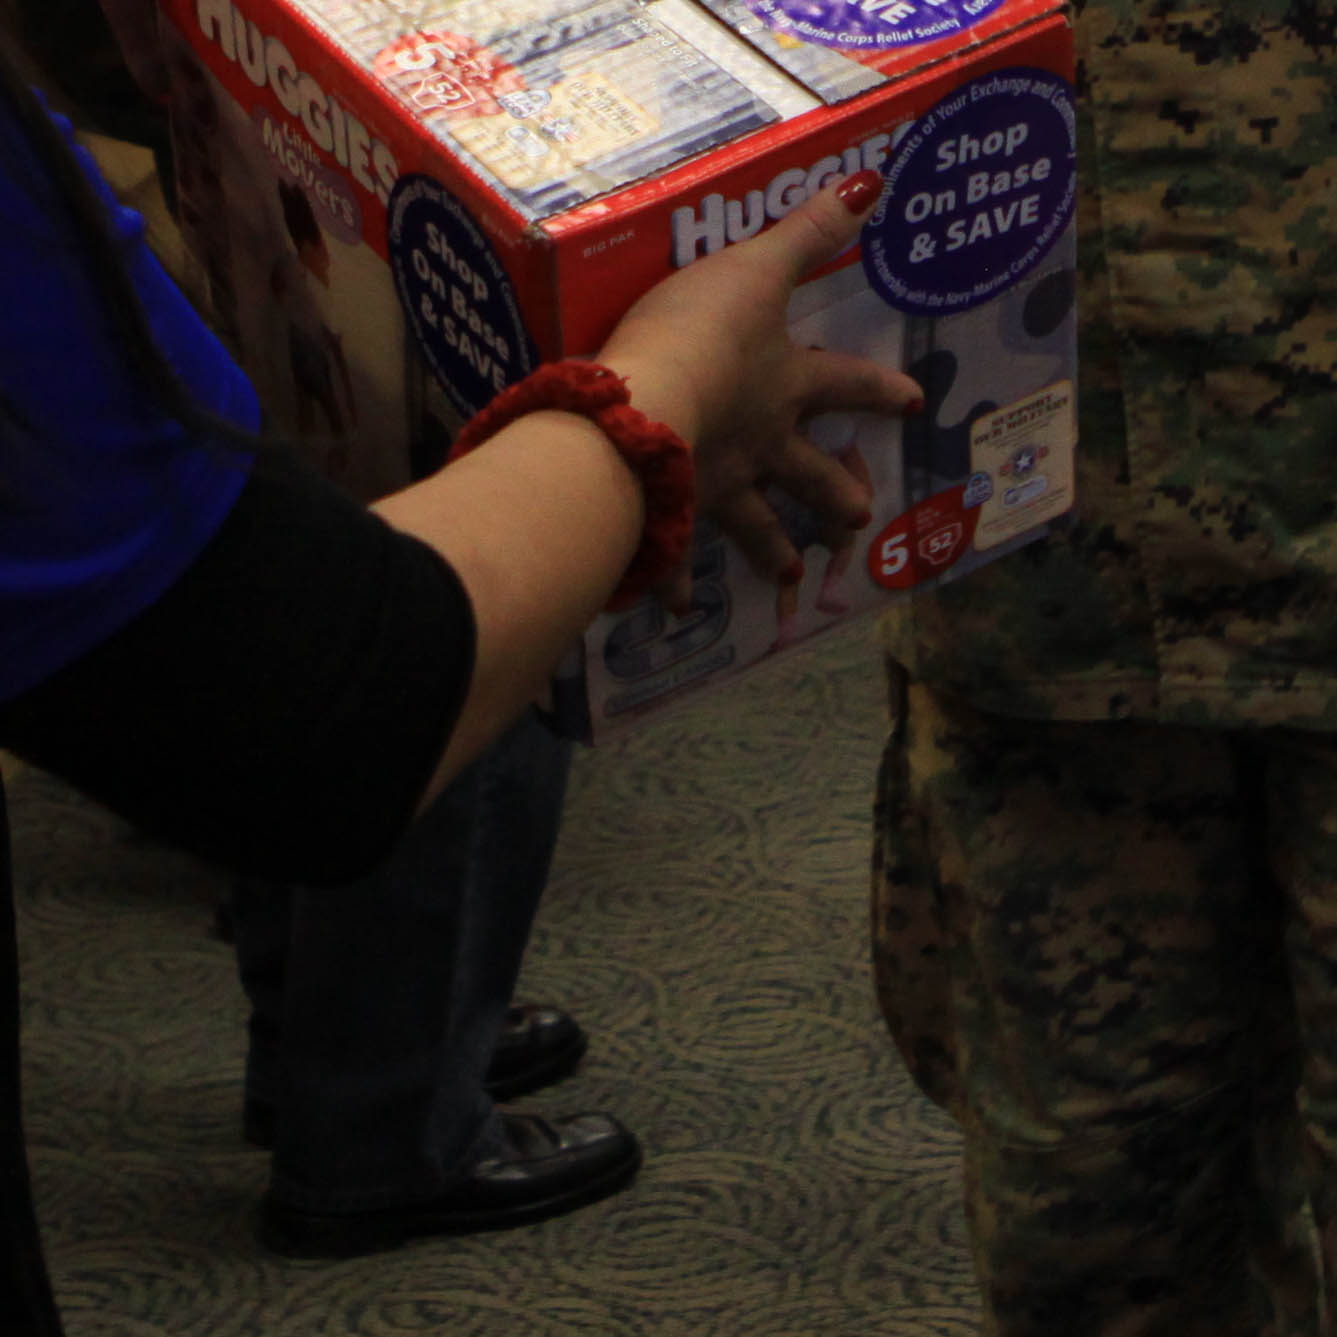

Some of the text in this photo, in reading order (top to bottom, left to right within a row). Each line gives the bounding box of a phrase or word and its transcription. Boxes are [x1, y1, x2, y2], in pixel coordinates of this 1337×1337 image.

[394, 42, 457, 71] 5
[837, 31, 874, 45] Corps
[876, 28, 914, 44] Relief
[916, 17, 961, 38] Society
[429, 81, 462, 105] 52
[263, 116, 355, 227] Movers
[869, 135, 924, 226] Compliments
[921, 117, 937, 136] of
[935, 94, 967, 121] Your
[970, 76, 1032, 102] Exchange
[1031, 79, 1057, 100] and
[935, 122, 1029, 173] Shop
[904, 189, 956, 224] On
[967, 157, 1052, 205] Base
[909, 194, 1041, 264] & SAVE
[424, 220, 489, 301] Shop
[1010, 246, 1040, 273] Corps
[412, 247, 446, 302] On
[450, 283, 510, 363] Base
[420, 291, 438, 328] &
[442, 314, 507, 393] SAVE
[880, 532, 909, 576] 5
[928, 531, 953, 554] 52
